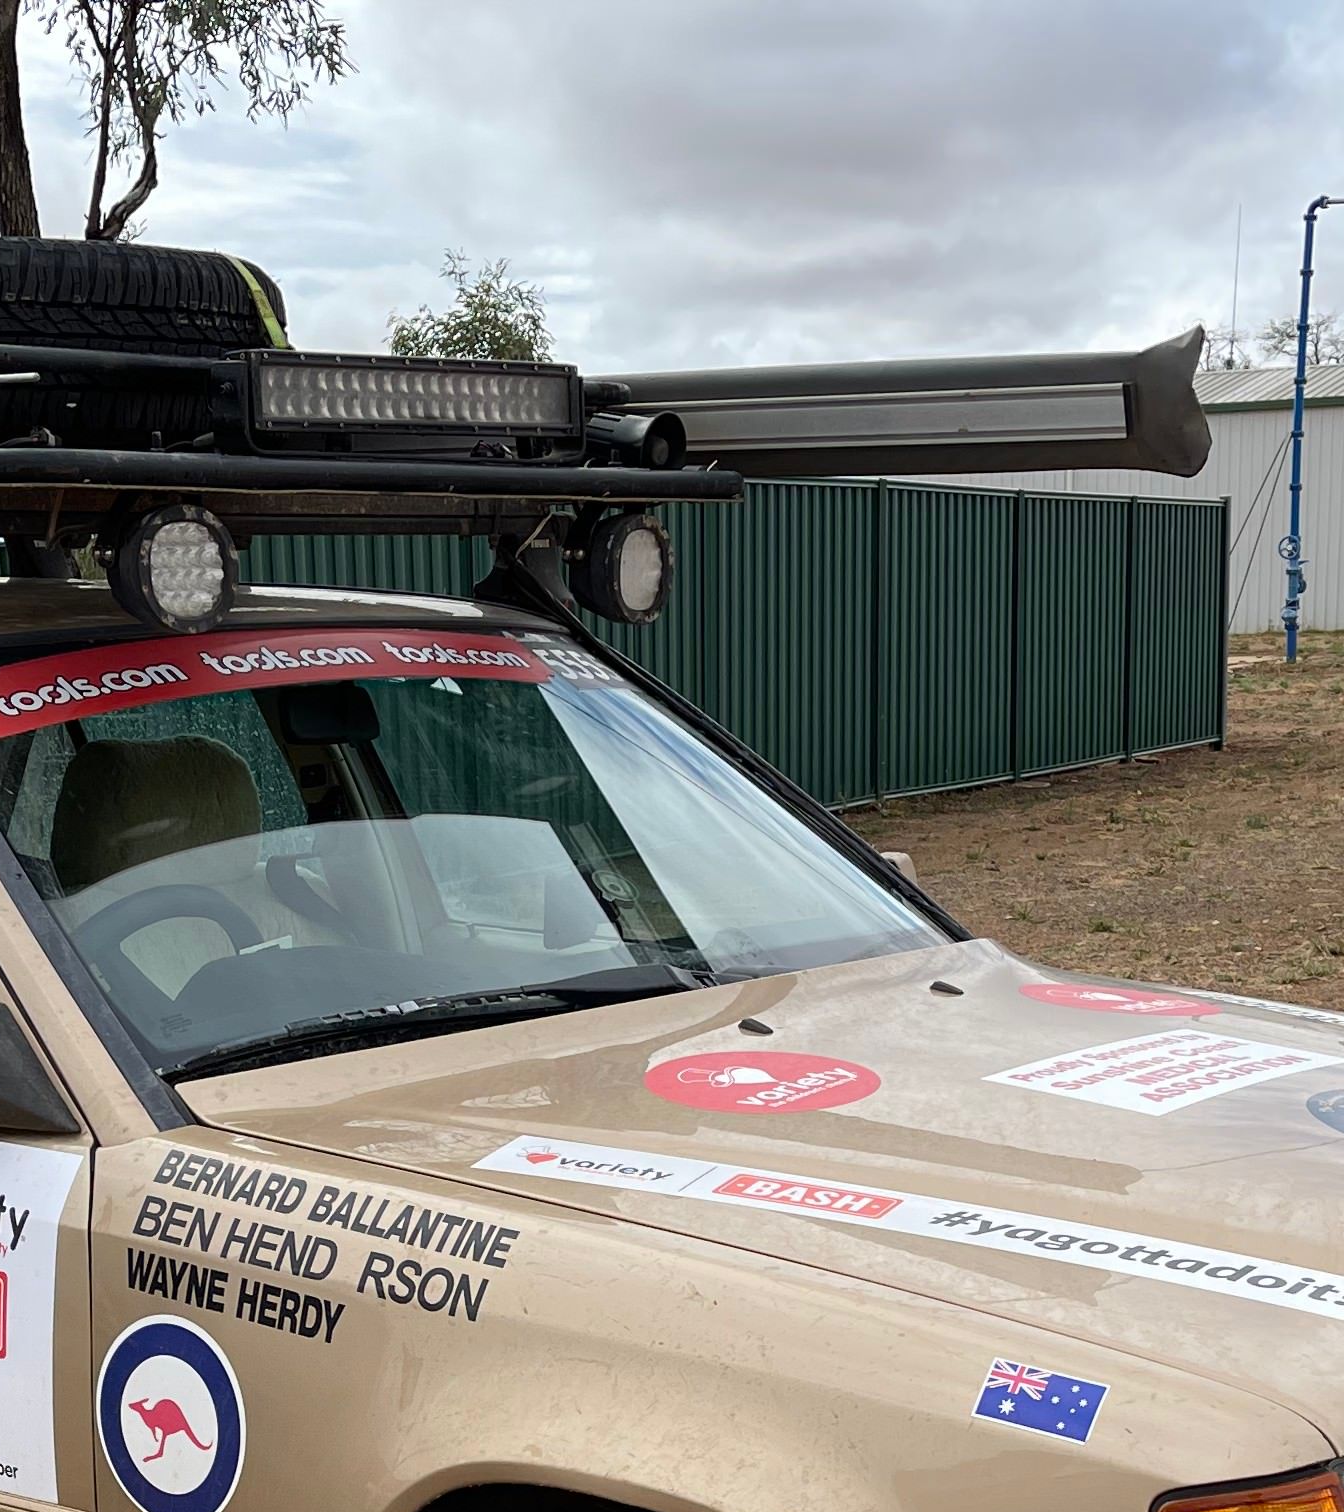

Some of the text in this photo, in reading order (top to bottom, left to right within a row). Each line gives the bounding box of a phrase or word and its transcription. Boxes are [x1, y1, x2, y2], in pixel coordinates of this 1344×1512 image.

[199, 646, 375, 675] tools.com
[381, 641, 530, 668] tools.com
[736, 1067, 858, 1106] variety
[1051, 1056, 1175, 1091] Sunshine
[1125, 1054, 1251, 1086] MEDICAL
[1139, 1054, 1312, 1102] ASSOCIATION
[560, 1157, 675, 1181] variety
[153, 1149, 521, 1268] BERNARD BALLANTINE
[743, 1179, 875, 1213] BASH
[132, 1195, 222, 1252] BEN
[127, 1247, 346, 1344] WAYNE HERDY
